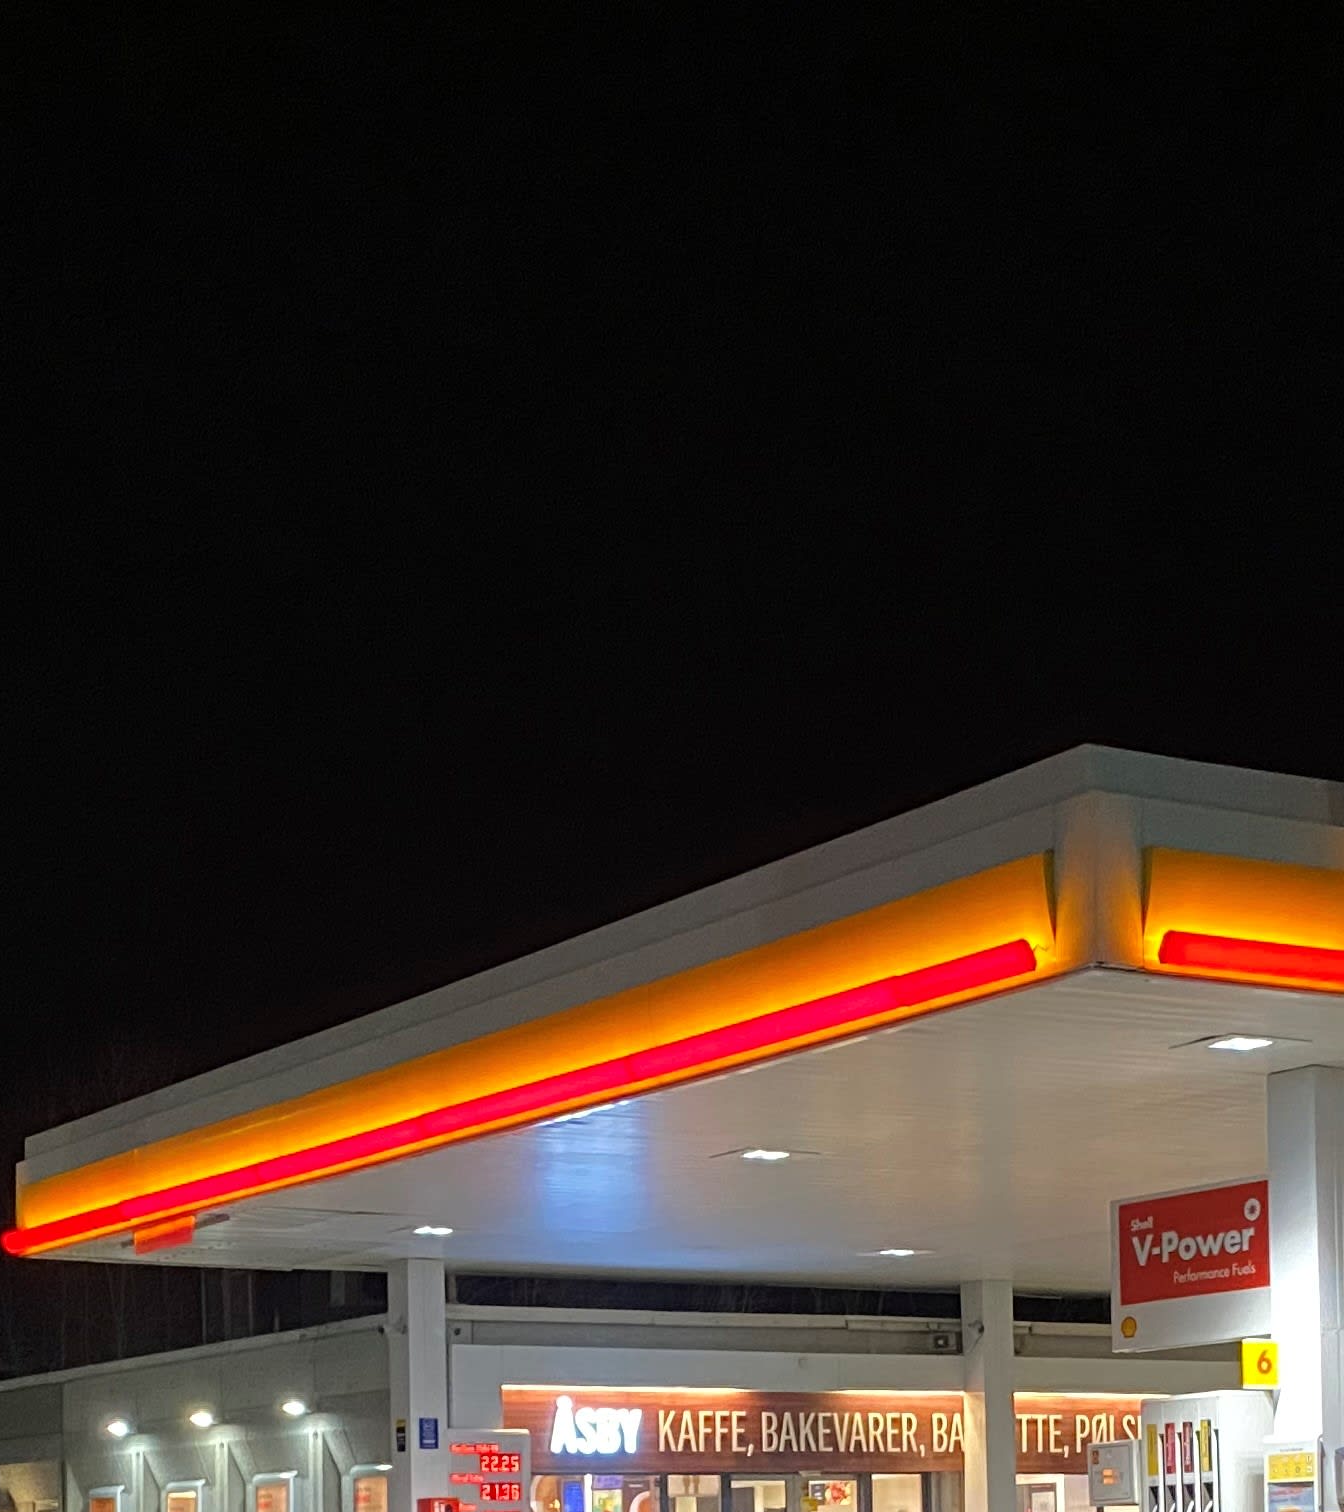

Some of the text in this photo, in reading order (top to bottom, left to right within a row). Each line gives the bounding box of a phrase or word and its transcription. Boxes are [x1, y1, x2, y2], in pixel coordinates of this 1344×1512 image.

[1131, 1216, 1153, 1231] Shell
[1131, 1227, 1256, 1267] V-Power
[1173, 1260, 1256, 1284] Performance Fuels
[1256, 1350, 1272, 1375] 6
[550, 1395, 642, 1454] ÅSBY
[658, 1410, 754, 1457] KAFFE,
[761, 1411, 926, 1457] BAKEVARER,
[481, 1455, 520, 1472] 22.25
[482, 1484, 520, 1501] 21.36
